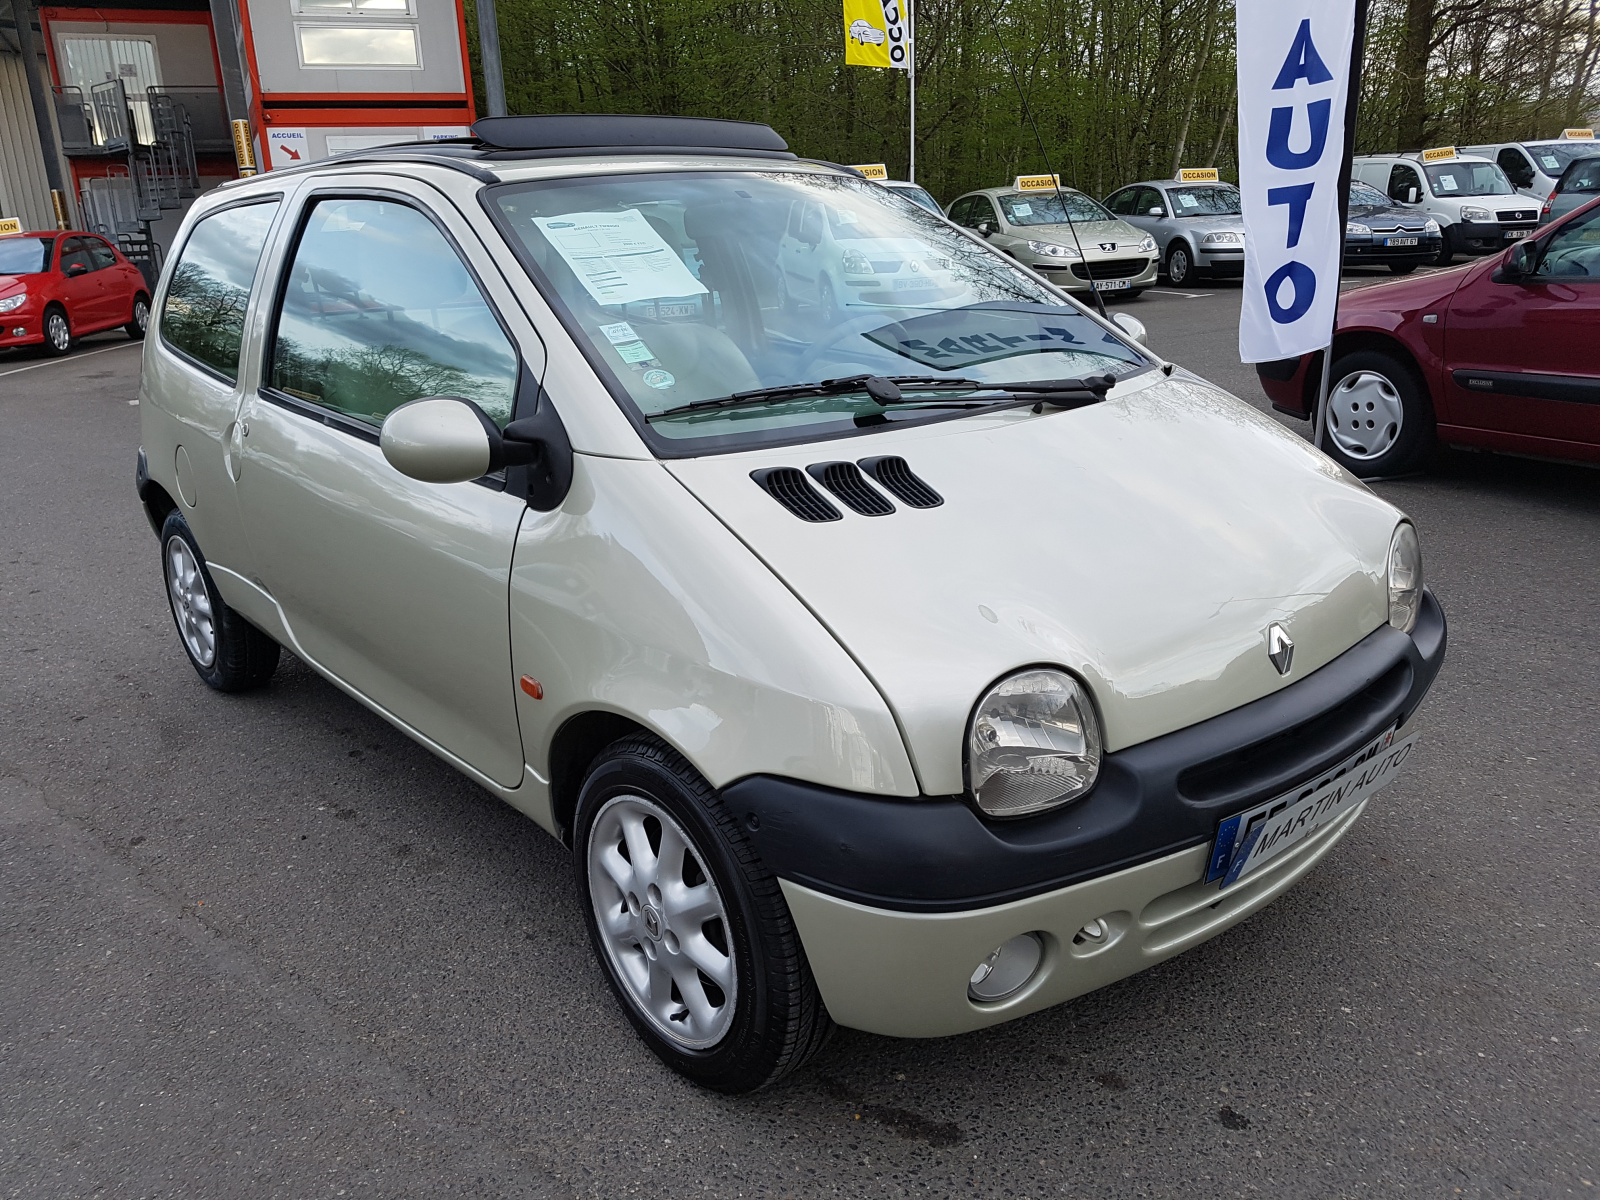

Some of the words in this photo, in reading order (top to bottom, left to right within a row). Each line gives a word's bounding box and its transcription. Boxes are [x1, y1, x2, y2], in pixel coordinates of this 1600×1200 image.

[880, 0, 905, 62] OCC
[234, 123, 245, 165] OCCASION
[1425, 149, 1454, 160] OCCASION
[1182, 171, 1216, 179] OCCASION
[1264, 18, 1334, 324] AUTO
[1253, 780, 1351, 858] MARTIN
[1348, 742, 1412, 797] AUTO
